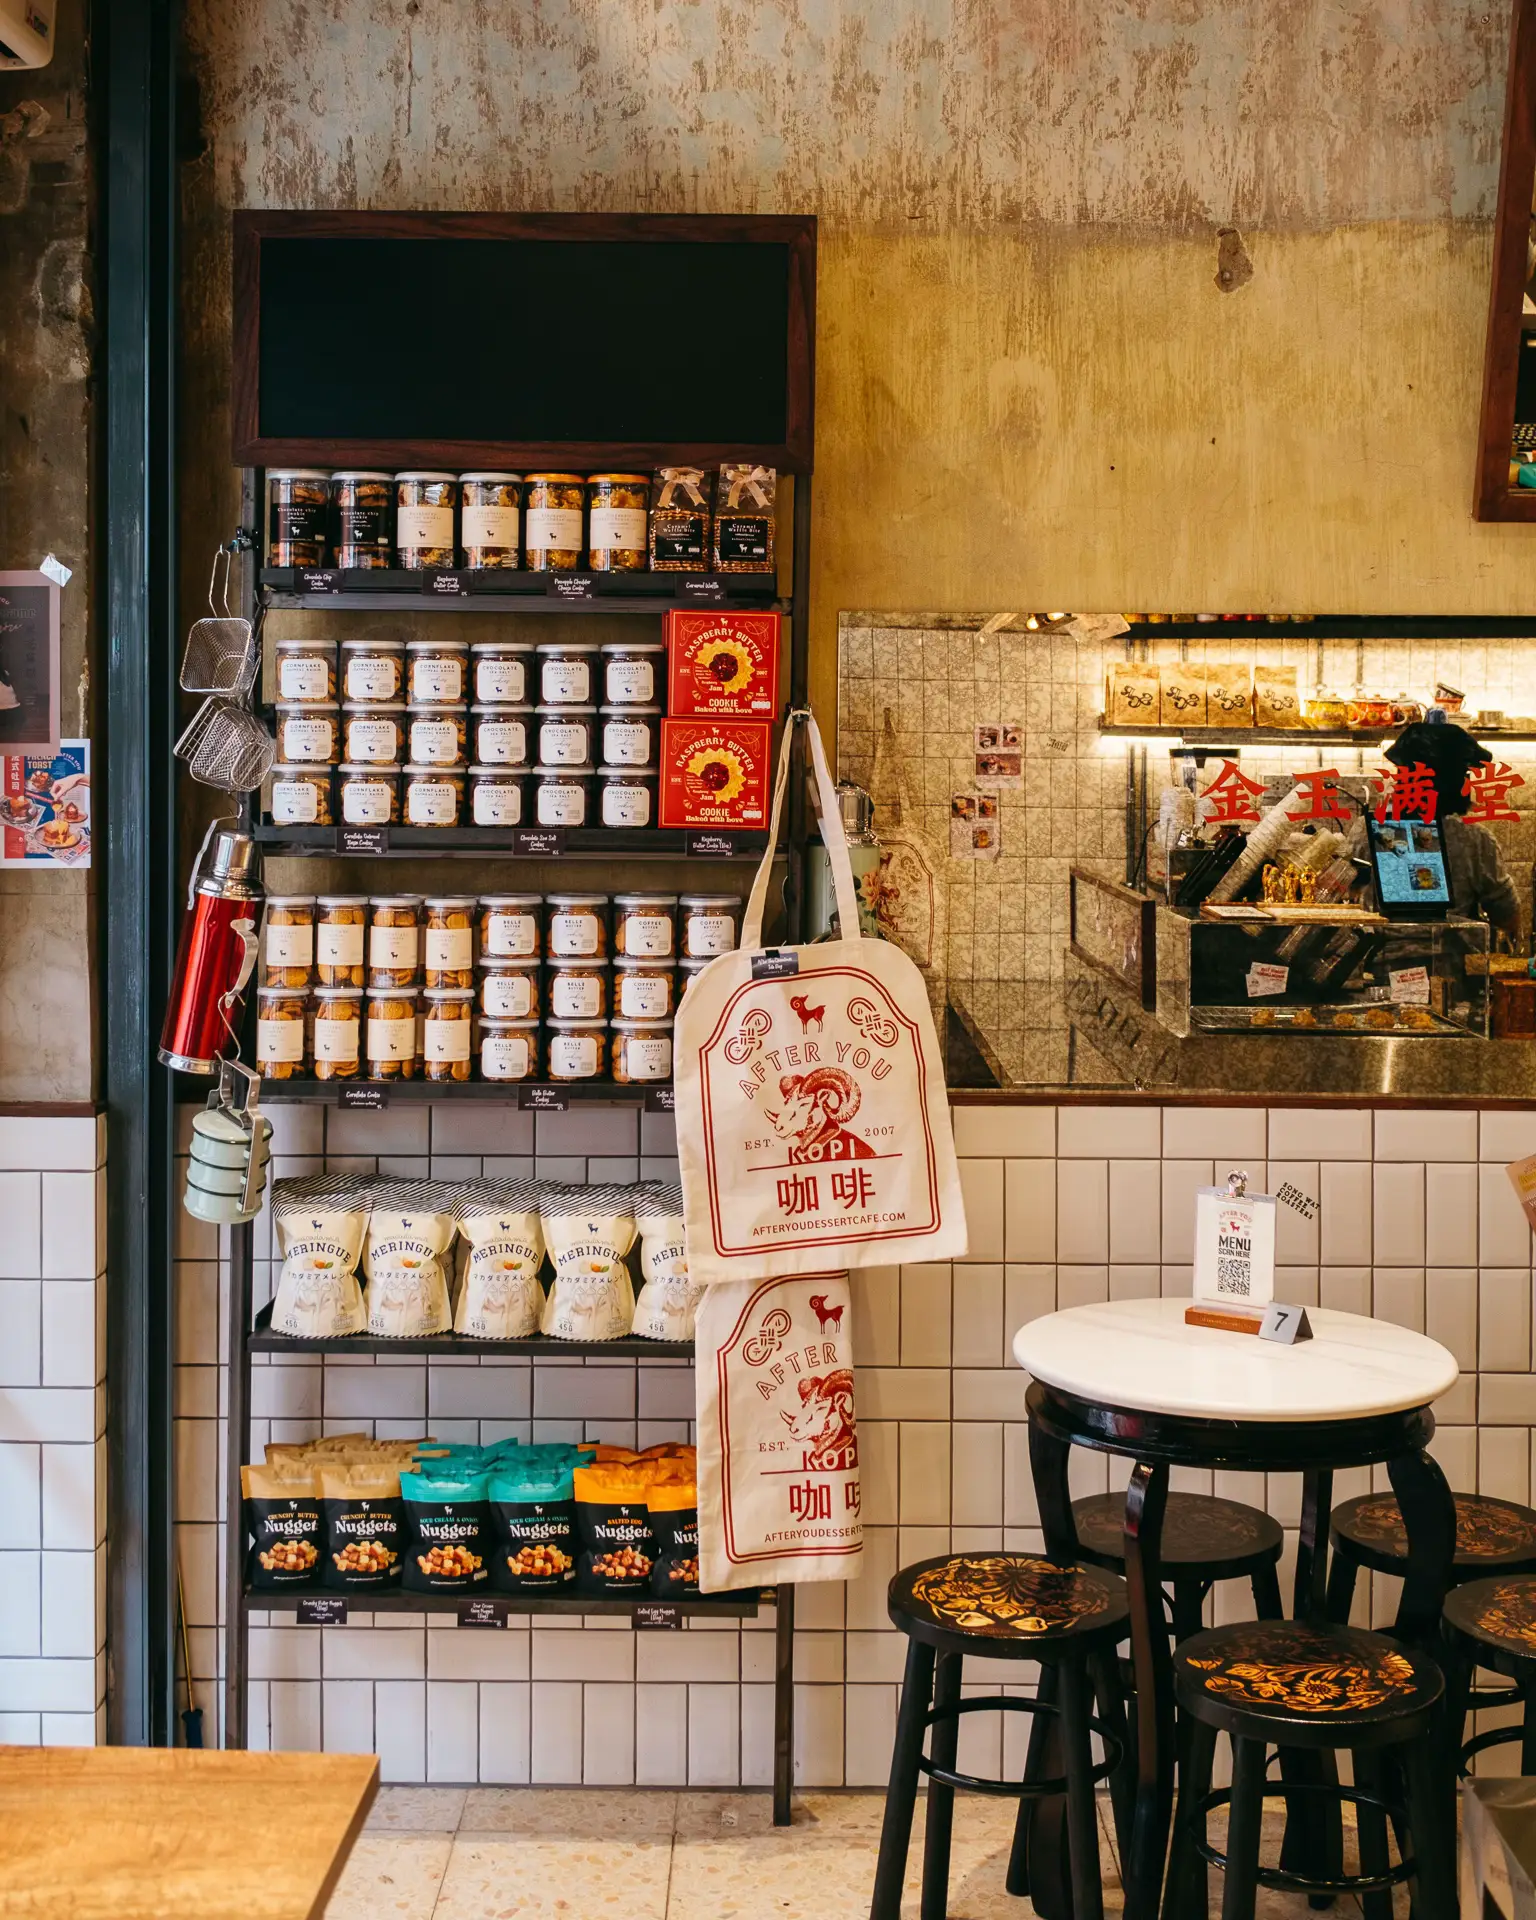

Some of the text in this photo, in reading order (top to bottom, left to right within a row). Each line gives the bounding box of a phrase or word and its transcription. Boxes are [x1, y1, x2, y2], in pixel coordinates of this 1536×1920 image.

[684, 628, 763, 662] RASPBERRY BUTTER
[709, 699, 739, 707] COOKIE
[676, 737, 755, 771] RASPBERRY BUTTER
[28, 761, 52, 769] TOAST
[1200, 758, 1526, 825] 金玉满堂
[700, 808, 730, 816] COOKIE
[738, 1041, 893, 1100] AFTER YOU
[864, 1126, 895, 1137] 2007
[744, 1139, 775, 1151] EST.
[787, 1138, 856, 1166] KOPI
[776, 1167, 876, 1217] 咖啡
[1280, 1187, 1308, 1209] COFFEE
[1283, 1182, 1320, 1210] SONG WAT
[1276, 1192, 1313, 1220] ROASTERS
[752, 1212, 906, 1236] AFTERYOUDESSERTCAFE.COM
[287, 1242, 352, 1263] MERINGUE
[473, 1243, 539, 1264] MERINGUE
[1218, 1248, 1250, 1259] SCAN HERE
[1219, 1235, 1251, 1251] MENU
[558, 1245, 624, 1266] MERINGU
[1274, 1311, 1288, 1332] 7
[756, 1342, 838, 1401] AFTER
[759, 1441, 789, 1453] EST.
[268, 1512, 294, 1520] CRUNCHY
[264, 1520, 319, 1535] Nugget
[335, 1520, 397, 1535] Nuggets
[420, 1524, 479, 1540] Nuggets
[510, 1523, 570, 1539] Nuggets
[594, 1525, 653, 1541] Nuggets
